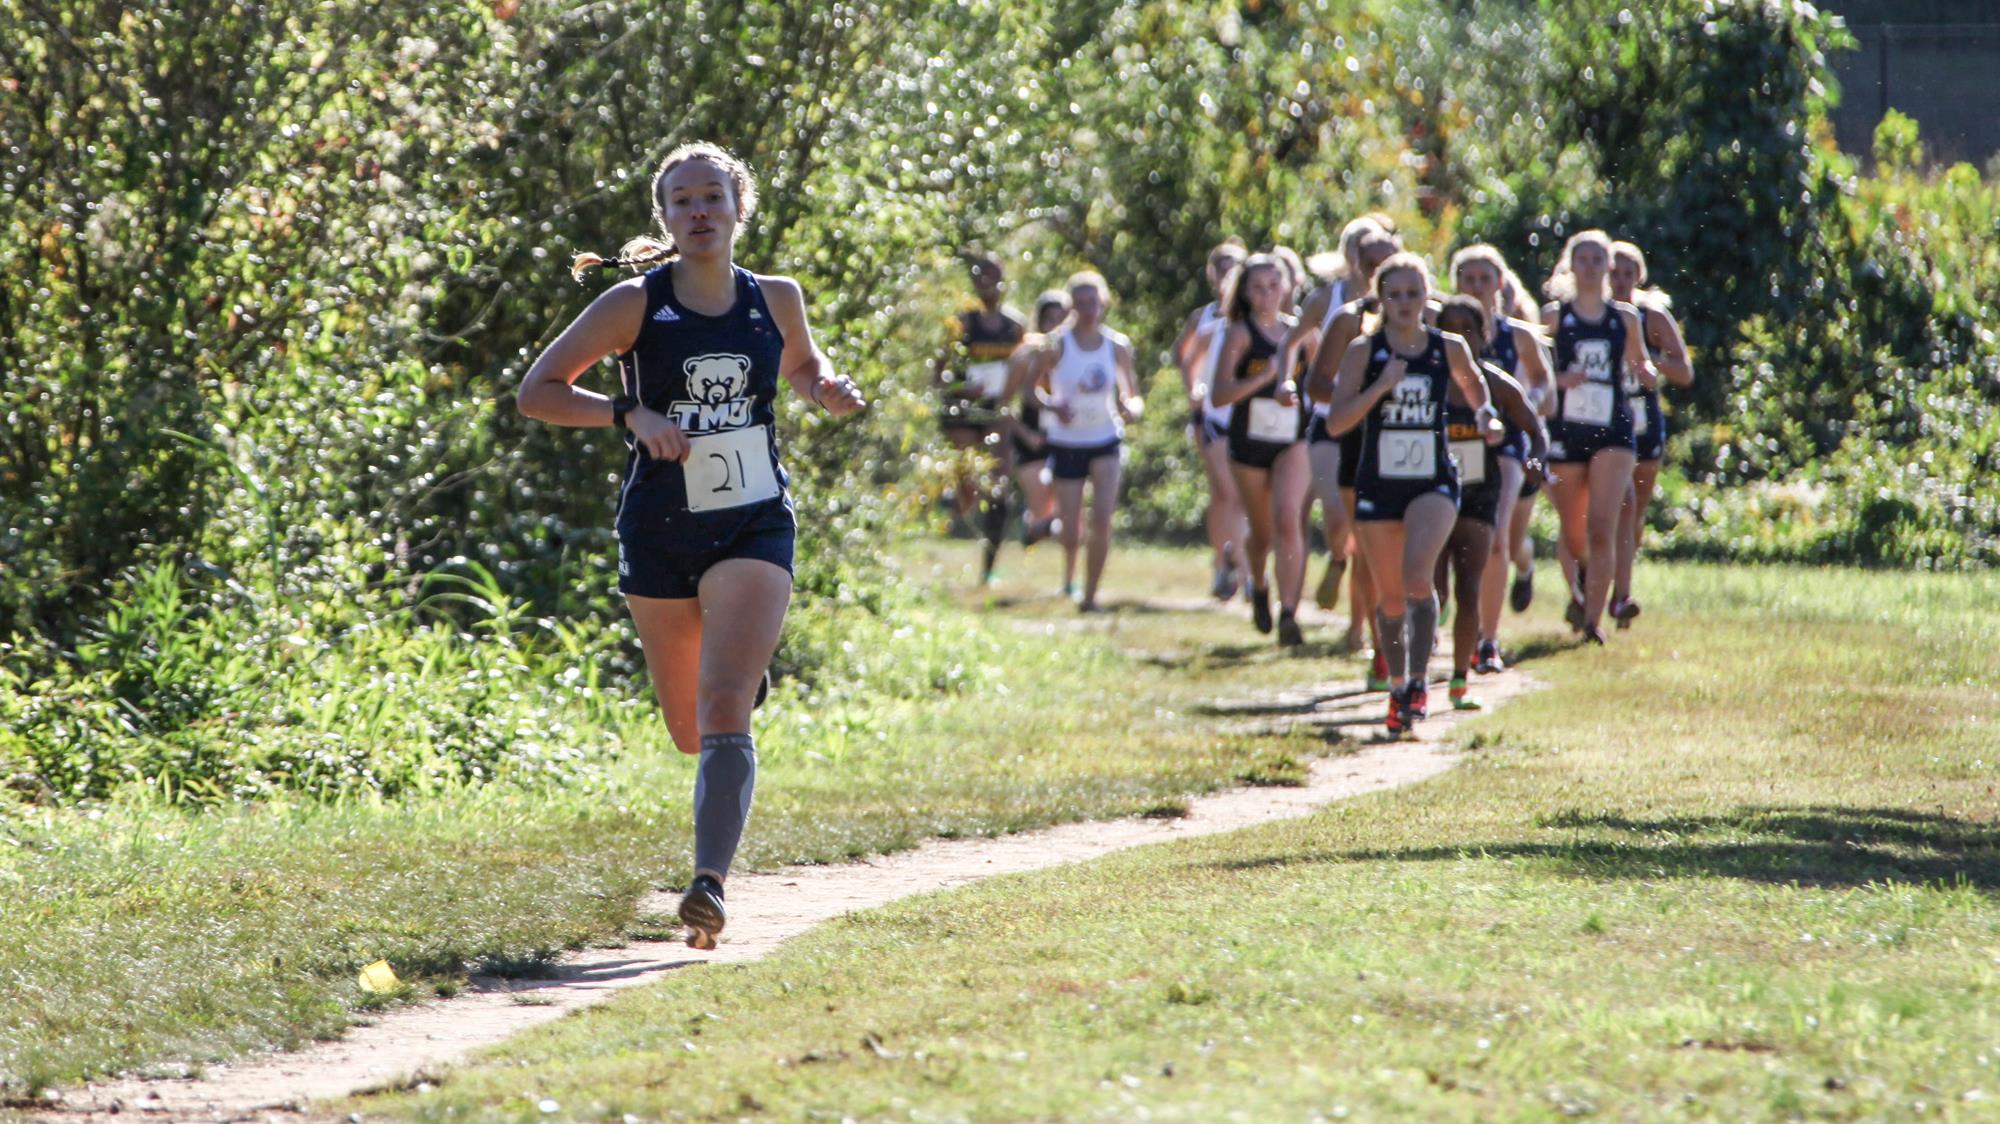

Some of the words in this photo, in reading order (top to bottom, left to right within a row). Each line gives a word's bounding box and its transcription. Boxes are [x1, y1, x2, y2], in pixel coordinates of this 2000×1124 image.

[668, 397, 755, 433] TMU
[1381, 401, 1437, 425] TMU
[1393, 439, 1424, 468] 20
[709, 450, 746, 493] 21
